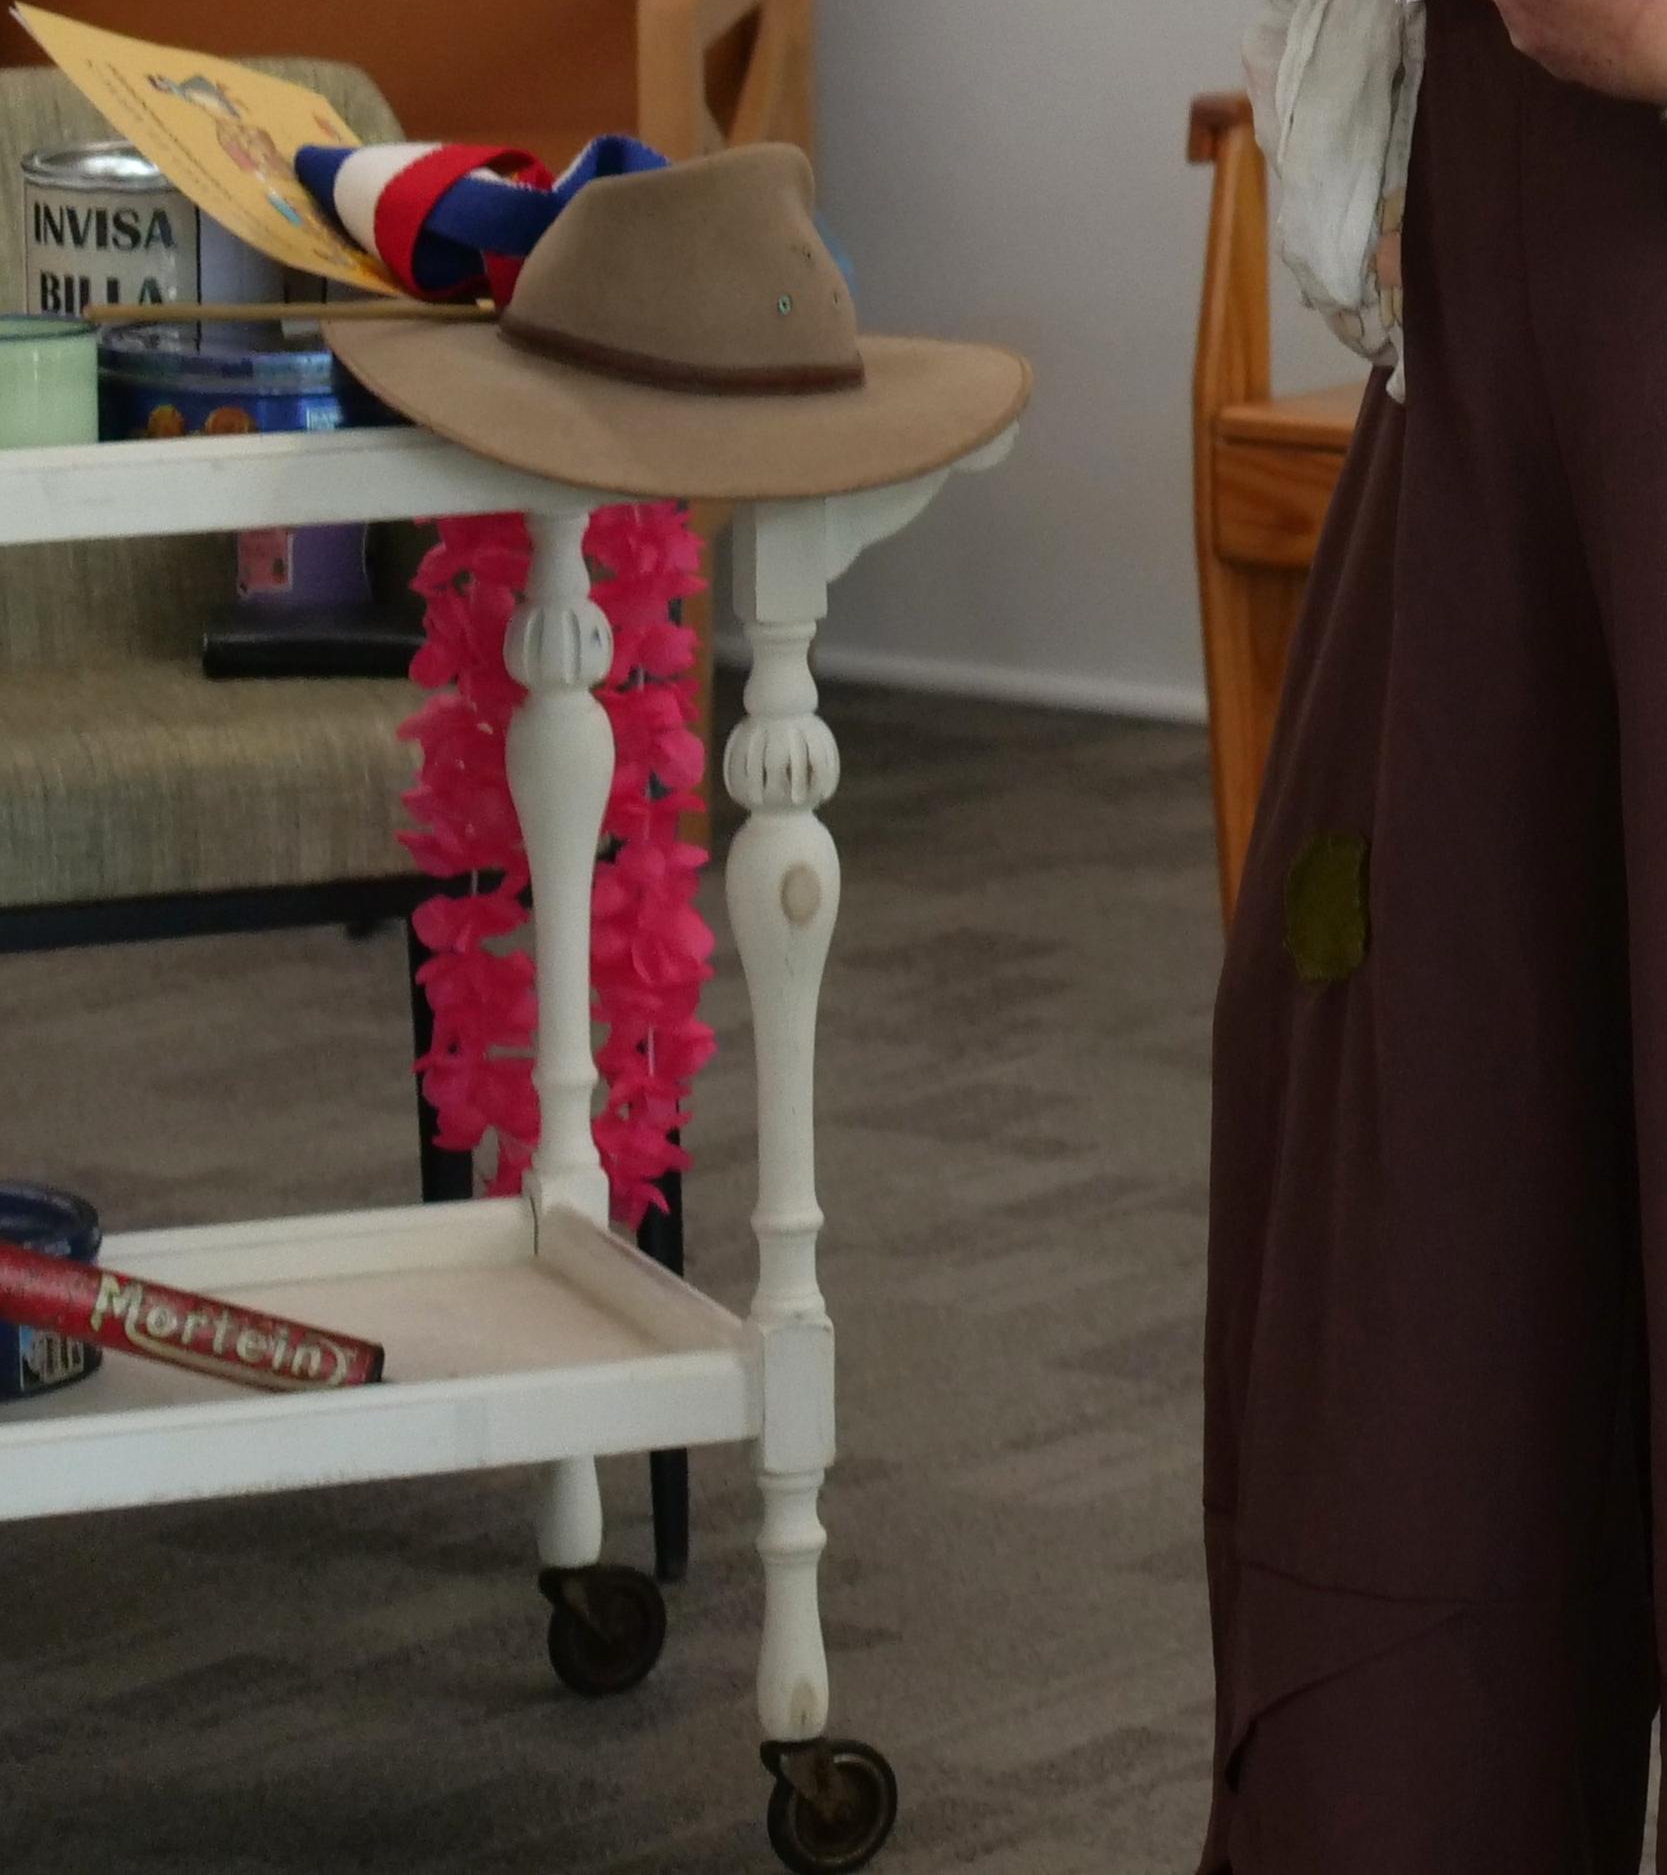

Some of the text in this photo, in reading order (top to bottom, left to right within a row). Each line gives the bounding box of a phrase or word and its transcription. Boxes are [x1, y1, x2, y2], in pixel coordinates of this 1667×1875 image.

[34, 201, 177, 253] INVISA
[40, 272, 164, 315] BILLA
[91, 1275, 336, 1384] Mortein
